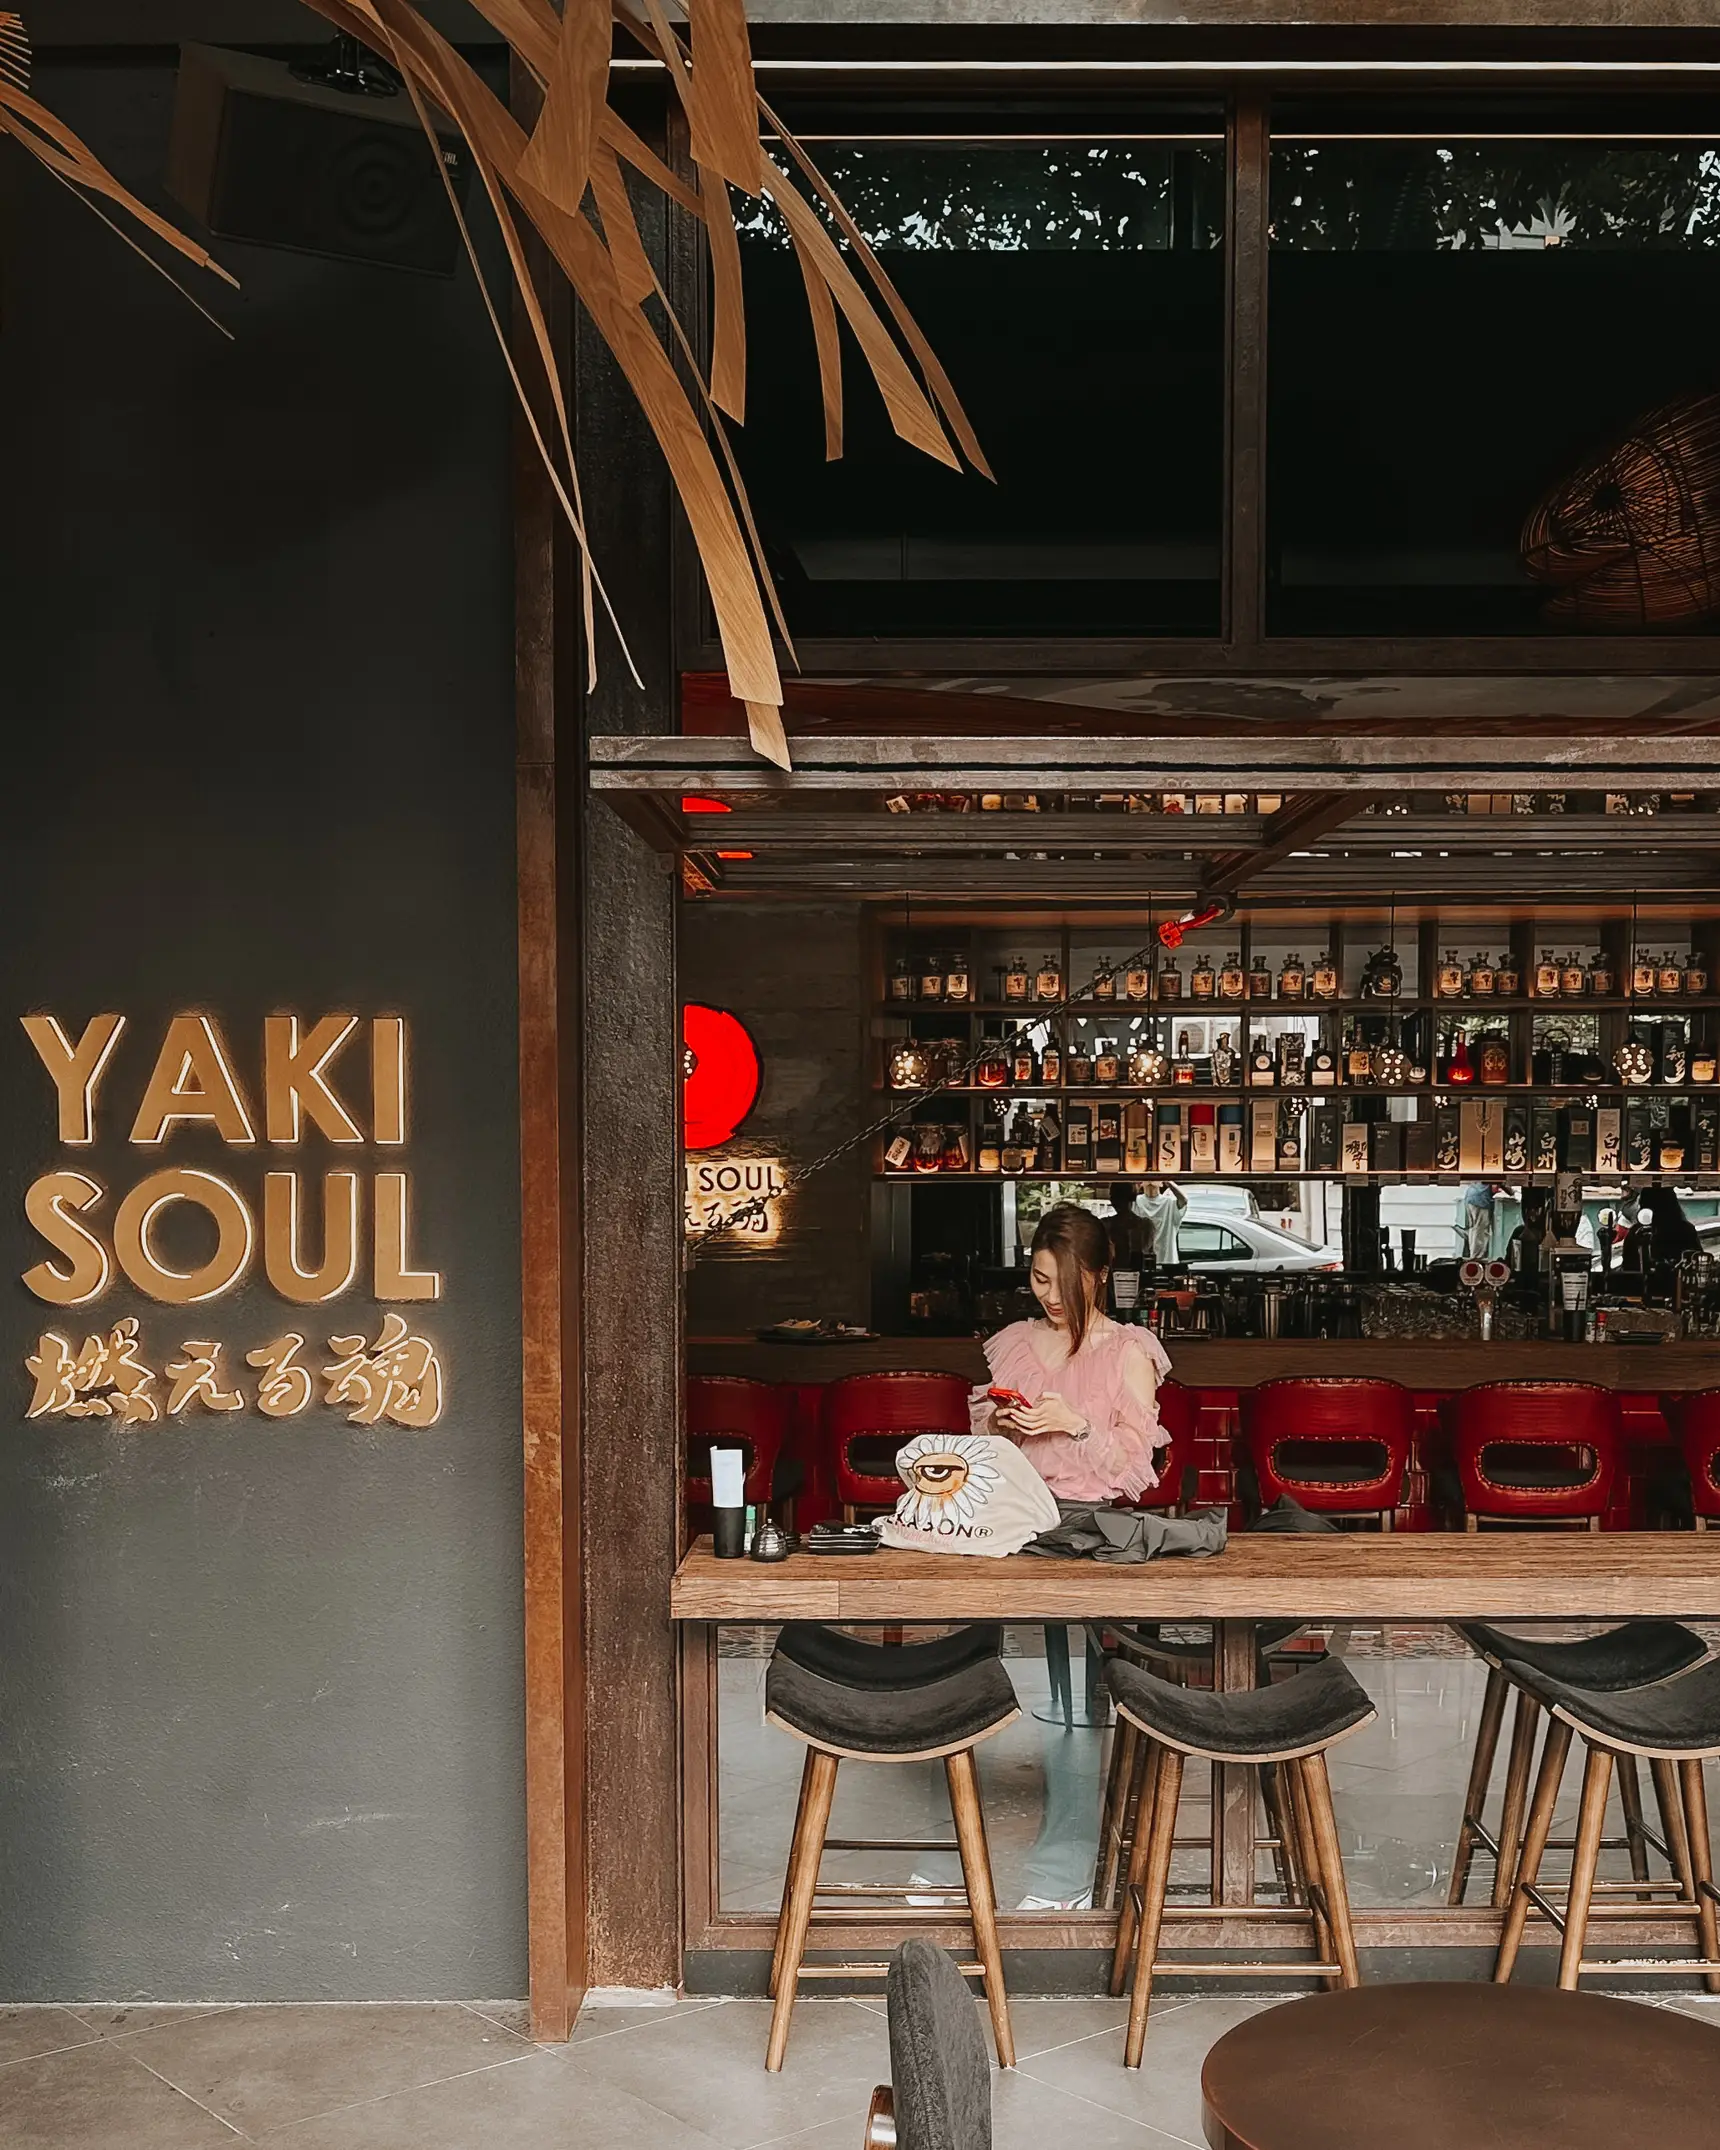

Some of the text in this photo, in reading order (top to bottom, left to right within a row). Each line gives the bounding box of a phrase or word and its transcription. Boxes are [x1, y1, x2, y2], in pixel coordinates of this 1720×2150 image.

[19, 1016, 405, 1144] YAKI
[20, 1170, 440, 1304] SOUL
[699, 1166, 778, 1191] SOUL
